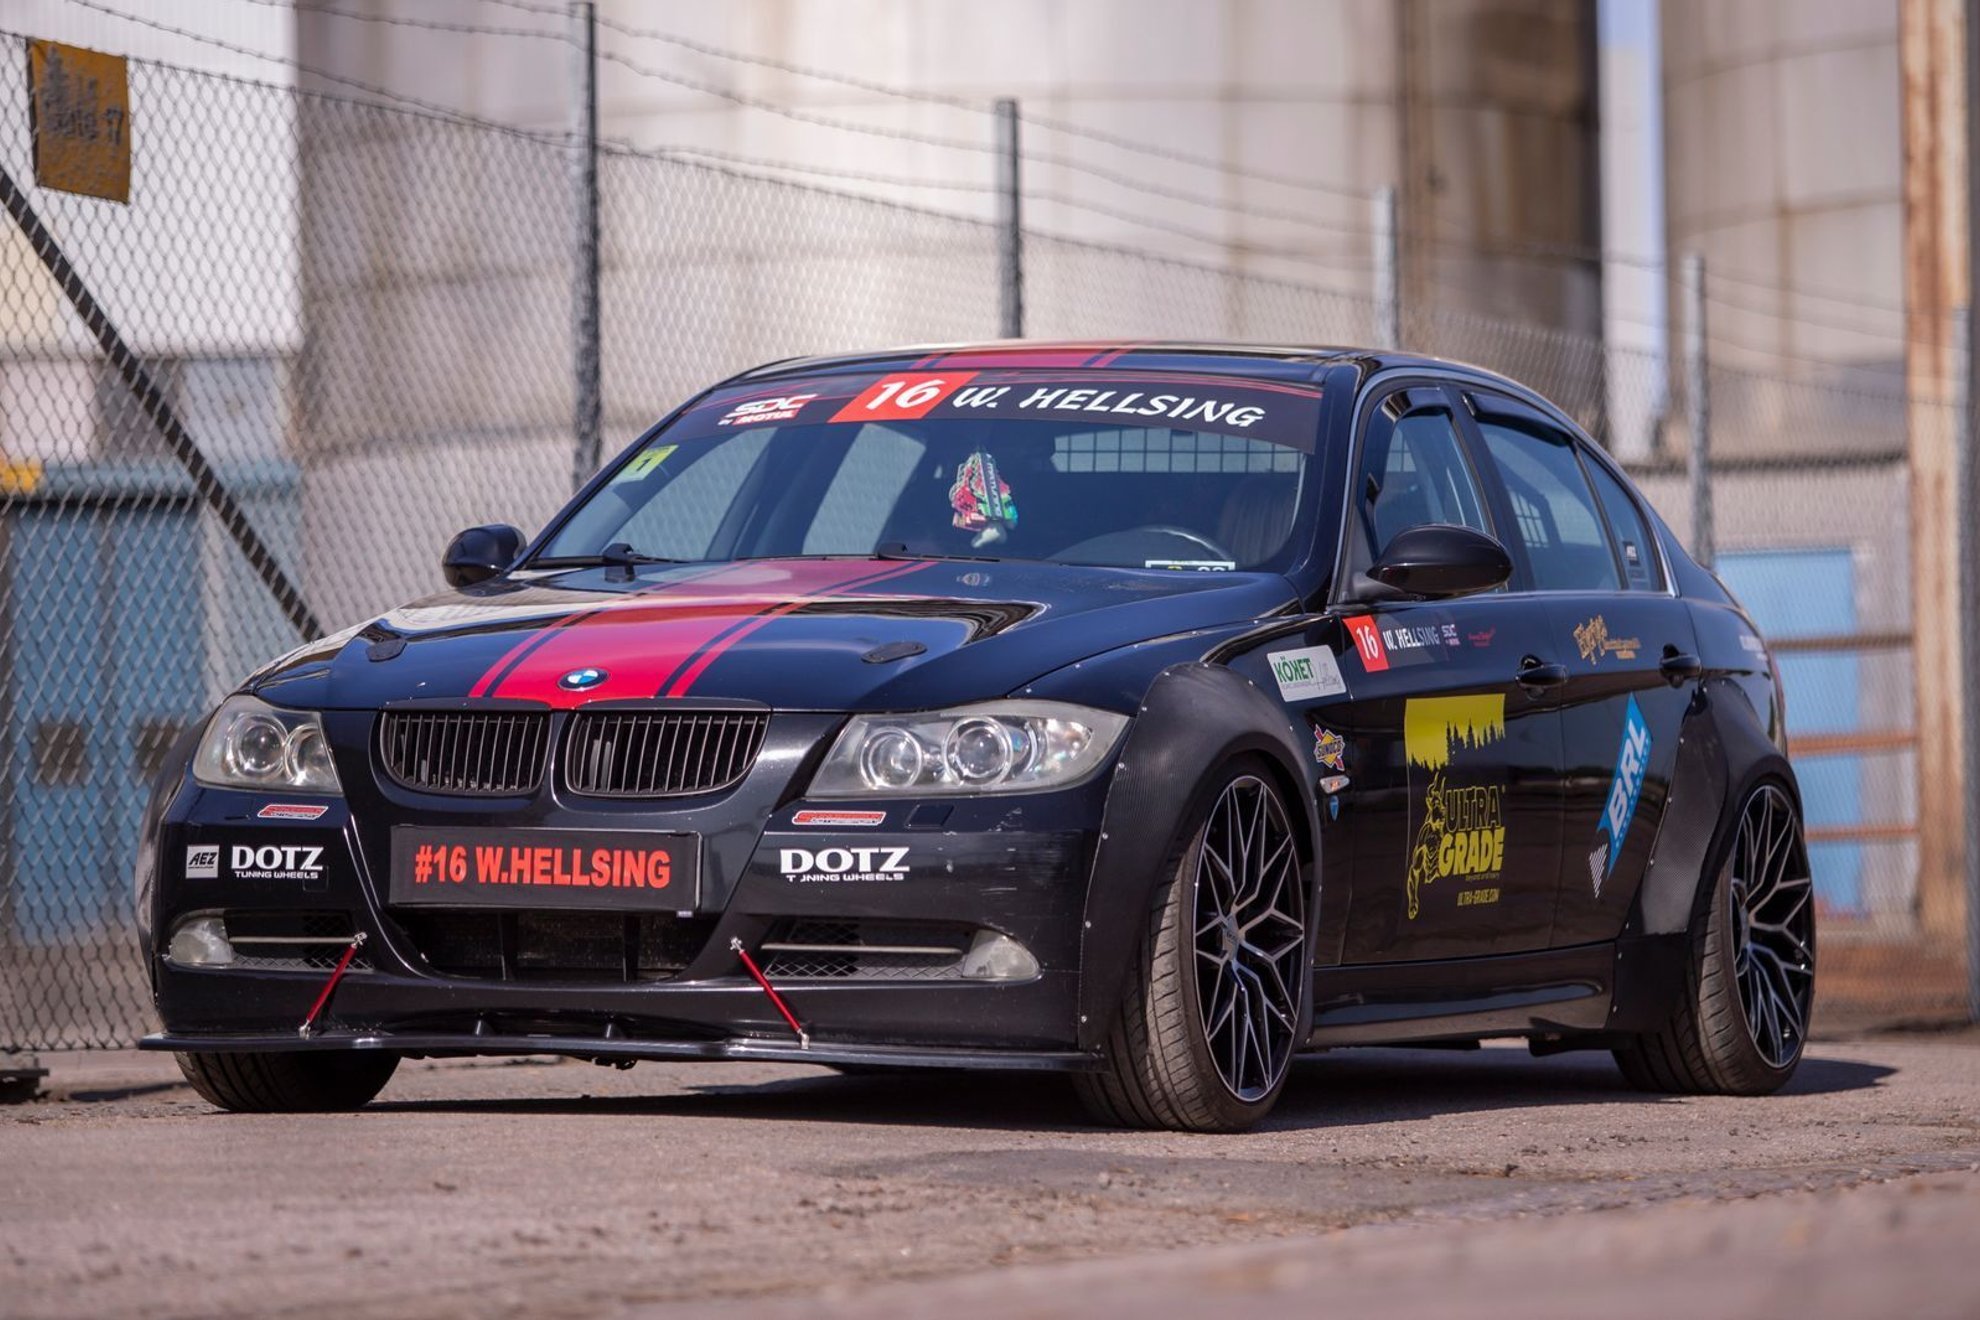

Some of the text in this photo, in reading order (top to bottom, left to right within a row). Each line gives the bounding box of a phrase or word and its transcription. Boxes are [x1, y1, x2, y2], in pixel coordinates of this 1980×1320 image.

[866, 379, 1266, 427] 16 W. HELLSING
[1356, 625, 1379, 660] 16
[1396, 625, 1441, 649] HELLSING
[1609, 718, 1646, 840] BRL
[1445, 785, 1502, 833] ULTRA
[188, 851, 218, 865] AEZ
[231, 845, 324, 871] DOTZ
[415, 845, 671, 889] #16 W.HELLSING
[780, 847, 910, 873] DOTZ
[1438, 826, 1505, 878] GRADE
[274, 871, 318, 879] WHEELS
[843, 873, 904, 882] WHEELS
